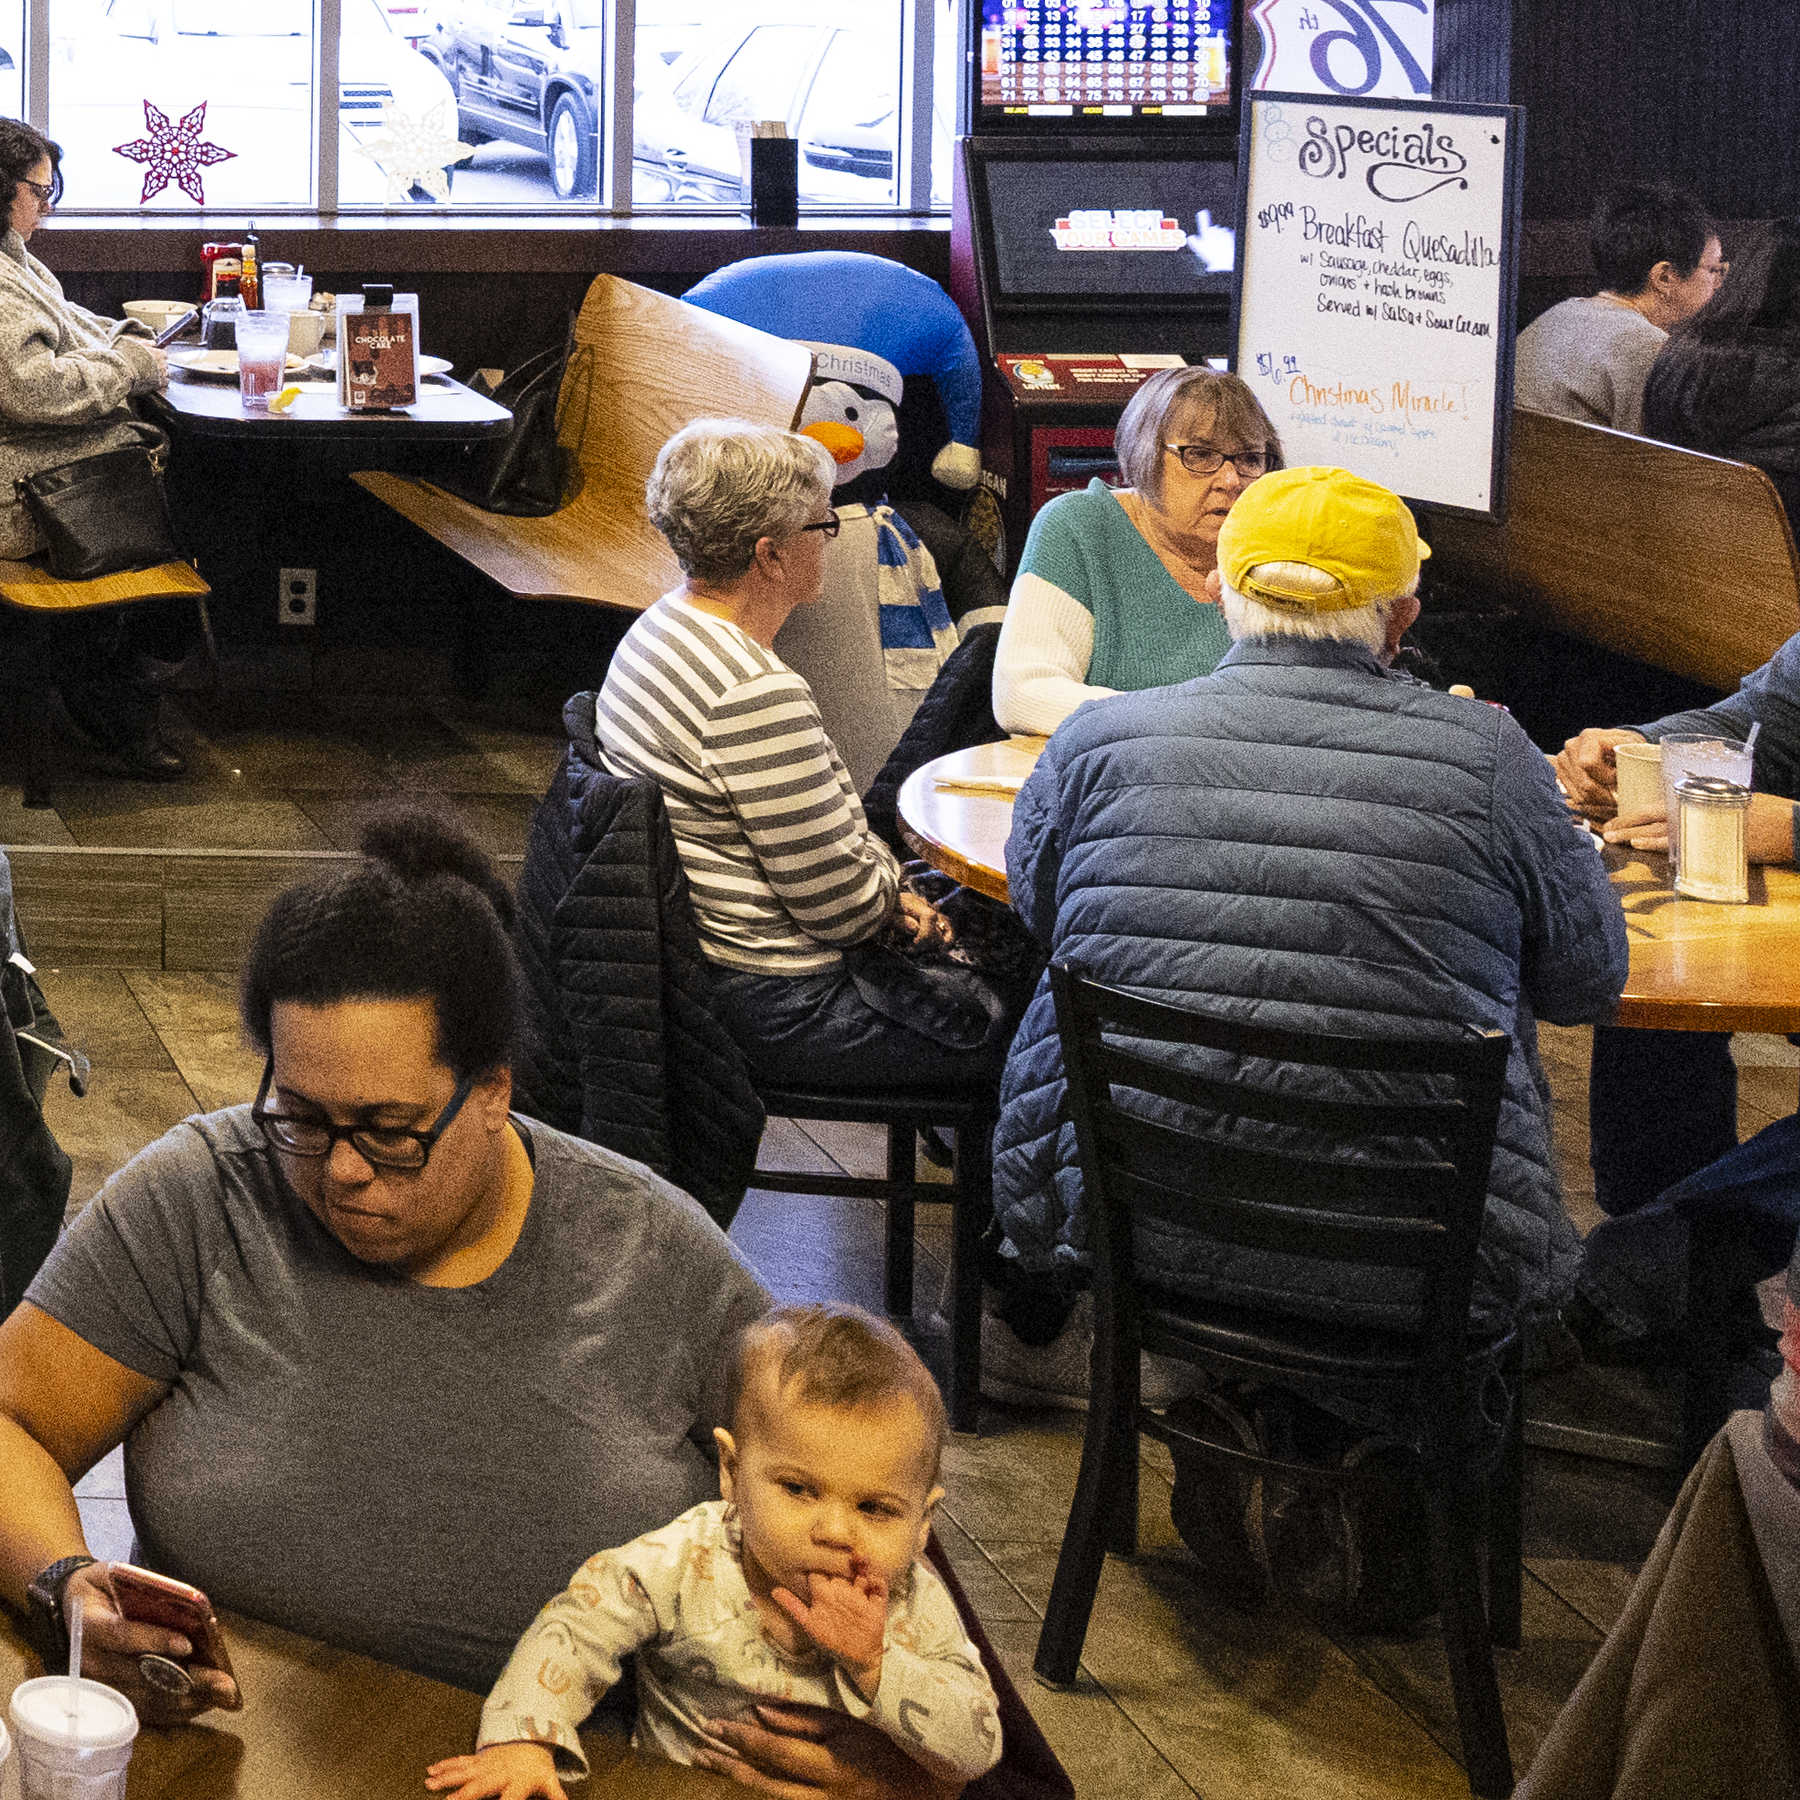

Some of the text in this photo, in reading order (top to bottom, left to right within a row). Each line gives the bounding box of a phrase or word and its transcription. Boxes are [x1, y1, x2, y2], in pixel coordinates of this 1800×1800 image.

[1024, 11, 1210, 21] 12 13 17 19 20
[1002, 24, 1016, 34] 21
[1023, 24, 1039, 34] 22
[1130, 24, 1145, 34] 27
[1194, 24, 1210, 34] 30
[1002, 37, 1016, 48] 31
[1001, 50, 1016, 61] 41
[1023, 50, 1039, 61] 42
[1065, 50, 1082, 61] 44
[1130, 50, 1145, 61] 47
[1001, 63, 1016, 74] 51
[1130, 63, 1145, 74] 57
[1172, 63, 1188, 74] 59
[1129, 77, 1145, 88] 67
[1001, 90, 1016, 101] 71
[1022, 90, 1038, 101] 72
[1065, 90, 1082, 101] 74
[1129, 90, 1144, 101] 77
[1298, 116, 1467, 199] Specials
[1071, 211, 1163, 230] SELECT
[1300, 206, 1389, 253] Breakfast
[1056, 230, 1187, 247] YOUR GAMES
[1300, 254, 1313, 265] w/
[1424, 268, 1454, 290] eggs,
[1320, 273, 1357, 290] onions
[1375, 278, 1401, 299] hash
[1405, 285, 1446, 304] browns
[1317, 293, 1361, 317] Served
[1381, 303, 1415, 326] Salsa
[1426, 312, 1454, 331] Sour
[1456, 315, 1492, 339] Cream
[355, 335, 406, 345] CHOCOLATE
[369, 341, 393, 350] CAKE
[816, 353, 893, 386] Christmas
[1289, 375, 1385, 414] Christmas
